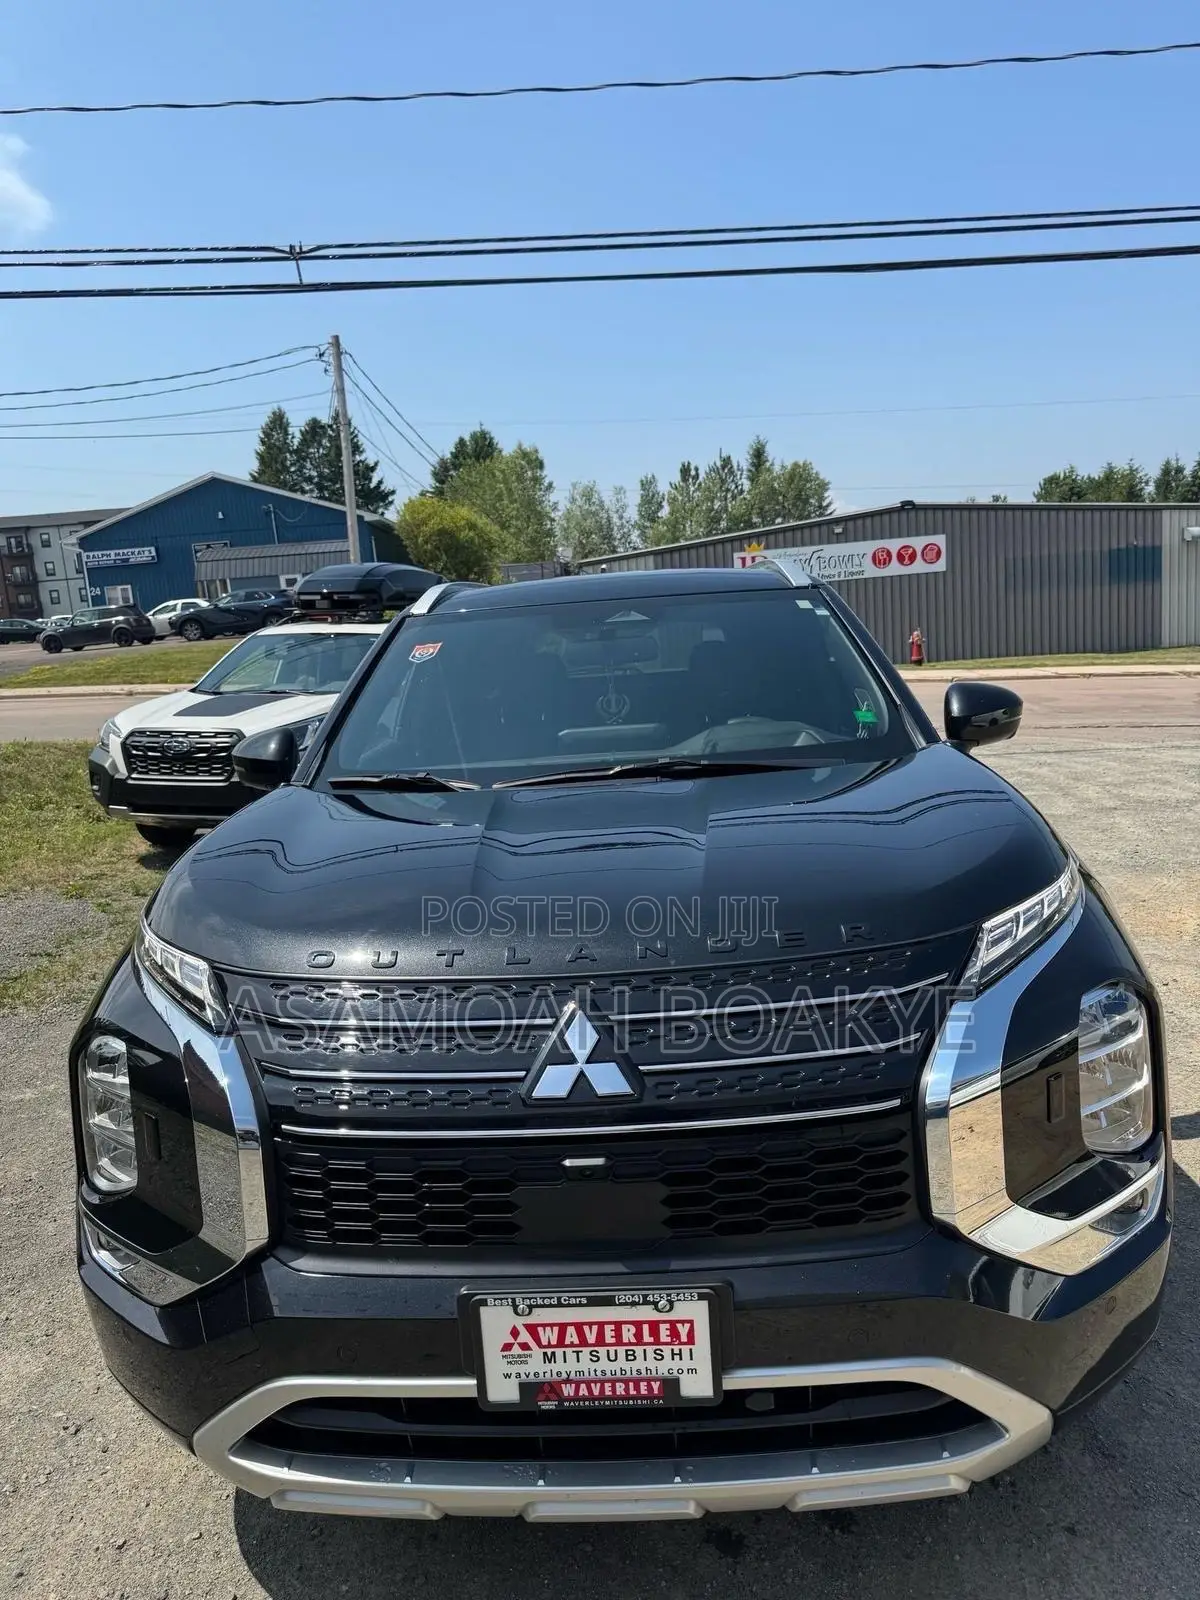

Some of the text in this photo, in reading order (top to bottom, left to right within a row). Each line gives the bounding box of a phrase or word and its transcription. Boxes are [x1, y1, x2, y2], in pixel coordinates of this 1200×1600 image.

[86, 552, 112, 560] RALPH
[90, 587, 101, 596] 24
[306, 923, 874, 968] OUTLANDER
[487, 1292, 698, 1306] Best Backed Cars (204) 453-5453
[538, 1323, 691, 1347] WAVERLEY
[543, 1348, 694, 1364] MITSUBISHI
[503, 1366, 698, 1380] waverleymitsubishi.com
[561, 1381, 661, 1397] WAVERLEY
[563, 1399, 664, 1407] WAVERLEYMITSUBISHI.CA
